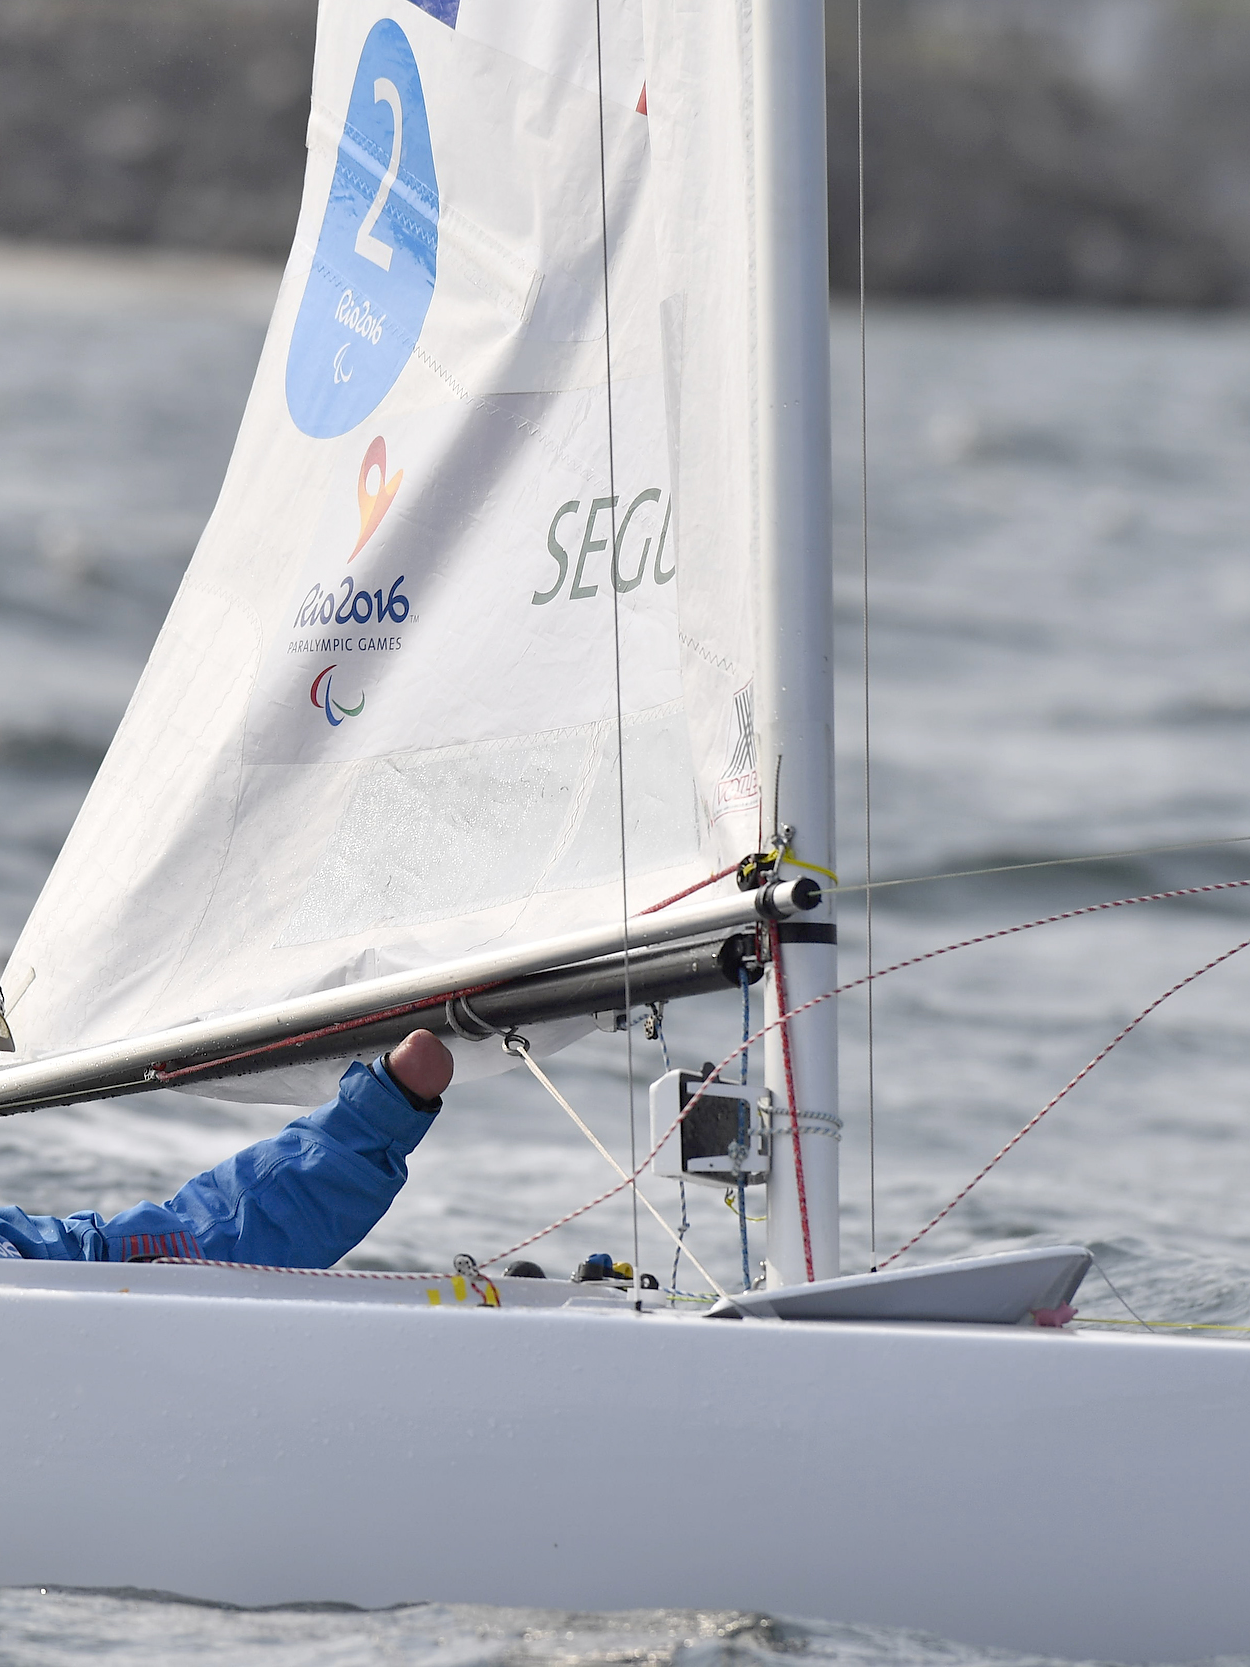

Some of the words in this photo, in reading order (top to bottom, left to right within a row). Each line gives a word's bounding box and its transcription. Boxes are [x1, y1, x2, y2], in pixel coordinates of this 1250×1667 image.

[354, 77, 403, 272] 2
[287, 638, 353, 654] PARALYMPIC
[358, 637, 402, 652] GAMES
